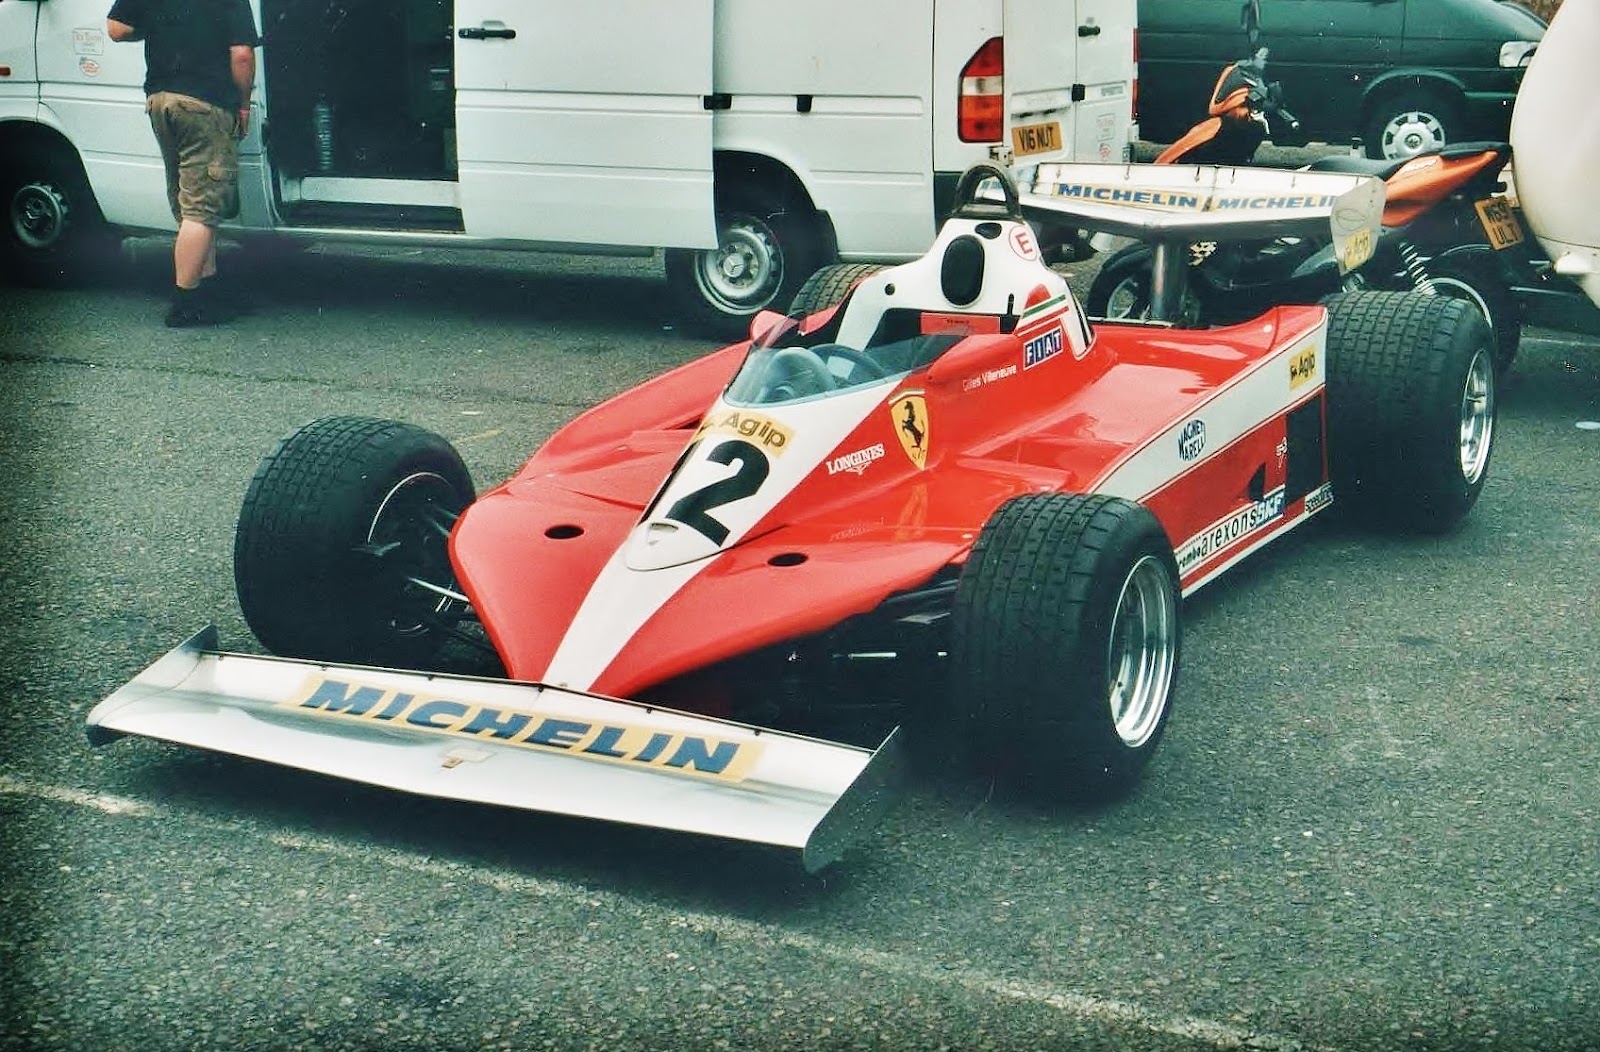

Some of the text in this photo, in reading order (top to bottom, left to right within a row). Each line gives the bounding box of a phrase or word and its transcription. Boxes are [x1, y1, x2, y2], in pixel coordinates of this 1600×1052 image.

[1036, 125, 1055, 150] NUT
[1057, 183, 1198, 208] MICHELIN
[1015, 231, 1033, 255] E
[1025, 330, 1062, 367] FIAT
[1298, 351, 1316, 378] Agip
[719, 412, 787, 449] Agip
[826, 443, 886, 476] LONGINES
[665, 440, 770, 547] 2
[1201, 508, 1256, 557] arexons
[1255, 491, 1285, 525] SKF
[300, 680, 741, 774] MICHELIN
